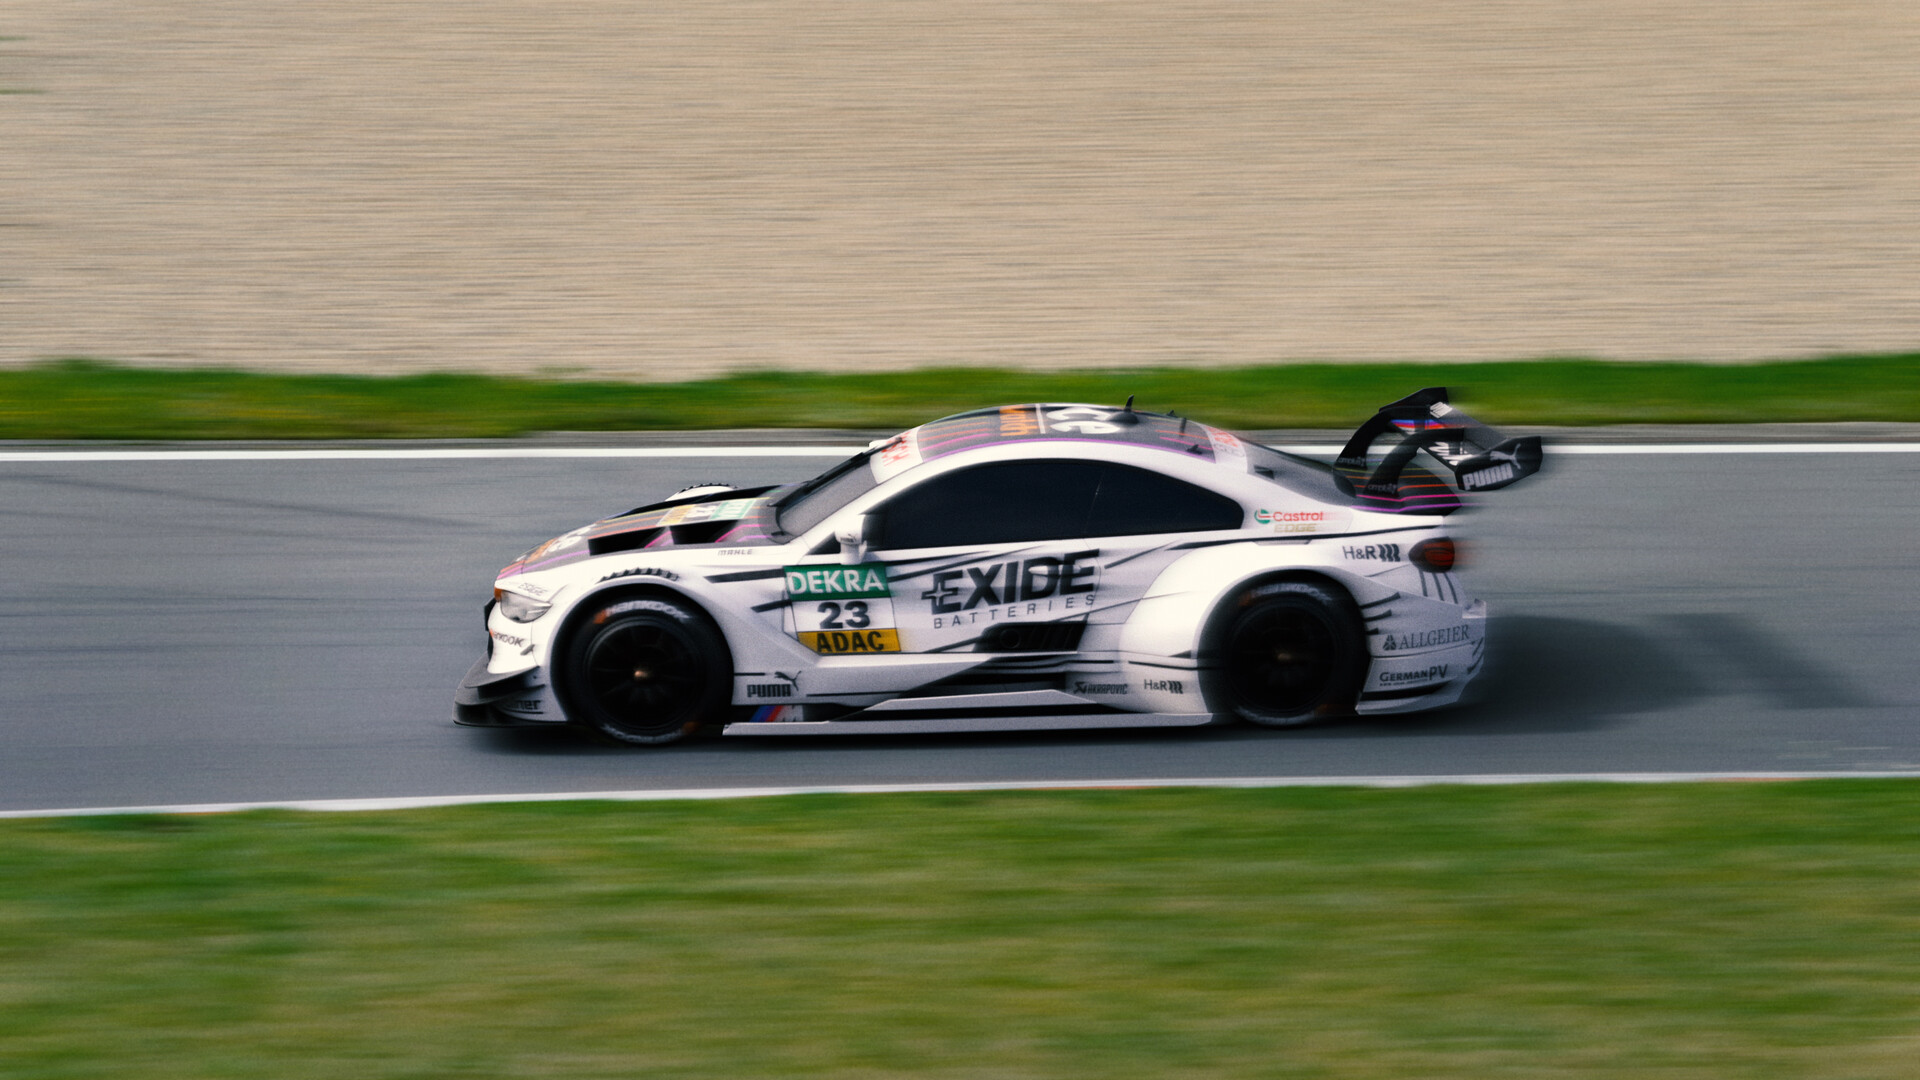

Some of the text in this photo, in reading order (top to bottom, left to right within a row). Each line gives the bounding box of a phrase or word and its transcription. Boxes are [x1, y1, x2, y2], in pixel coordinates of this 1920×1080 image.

[1462, 463, 1514, 491] PUMA
[1273, 511, 1323, 522] Castrol
[1274, 523, 1317, 533] EDGE
[717, 548, 753, 556] MAHLE
[785, 568, 885, 594] DEKRA
[921, 549, 1100, 615] EXIDE
[817, 601, 871, 629] 23
[933, 594, 1096, 629] BATTERIES
[816, 631, 885, 653] ADAC
[1398, 624, 1470, 650] ALLGEIER
[747, 684, 791, 698] PUMA
